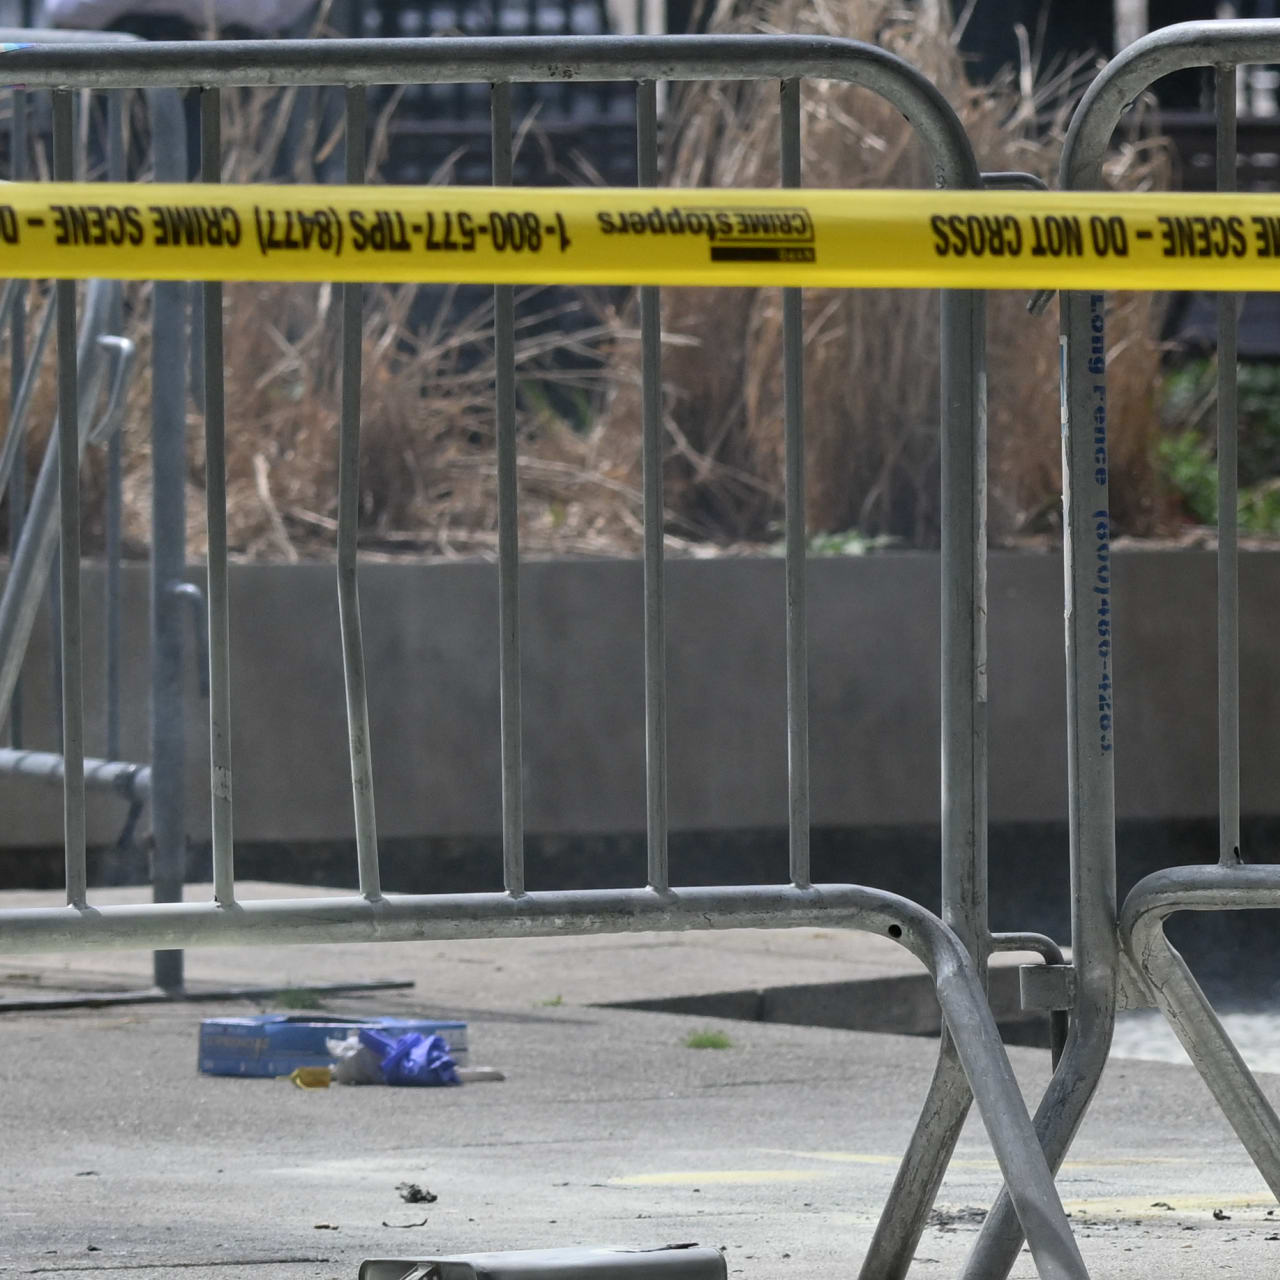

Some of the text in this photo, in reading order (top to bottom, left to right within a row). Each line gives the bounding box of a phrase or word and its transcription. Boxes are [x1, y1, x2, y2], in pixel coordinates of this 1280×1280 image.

[0, 205, 20, 246] D
[50, 205, 146, 247] SCENE
[150, 207, 243, 248] CRIME
[254, 207, 345, 257] (8477)
[349, 211, 572, 253] 1-800-577-TIPS
[929, 216, 1024, 257] CROSS
[1031, 216, 1085, 257] NOT
[1090, 216, 1128, 258] DO
[1157, 217, 1247, 258] SCENE
